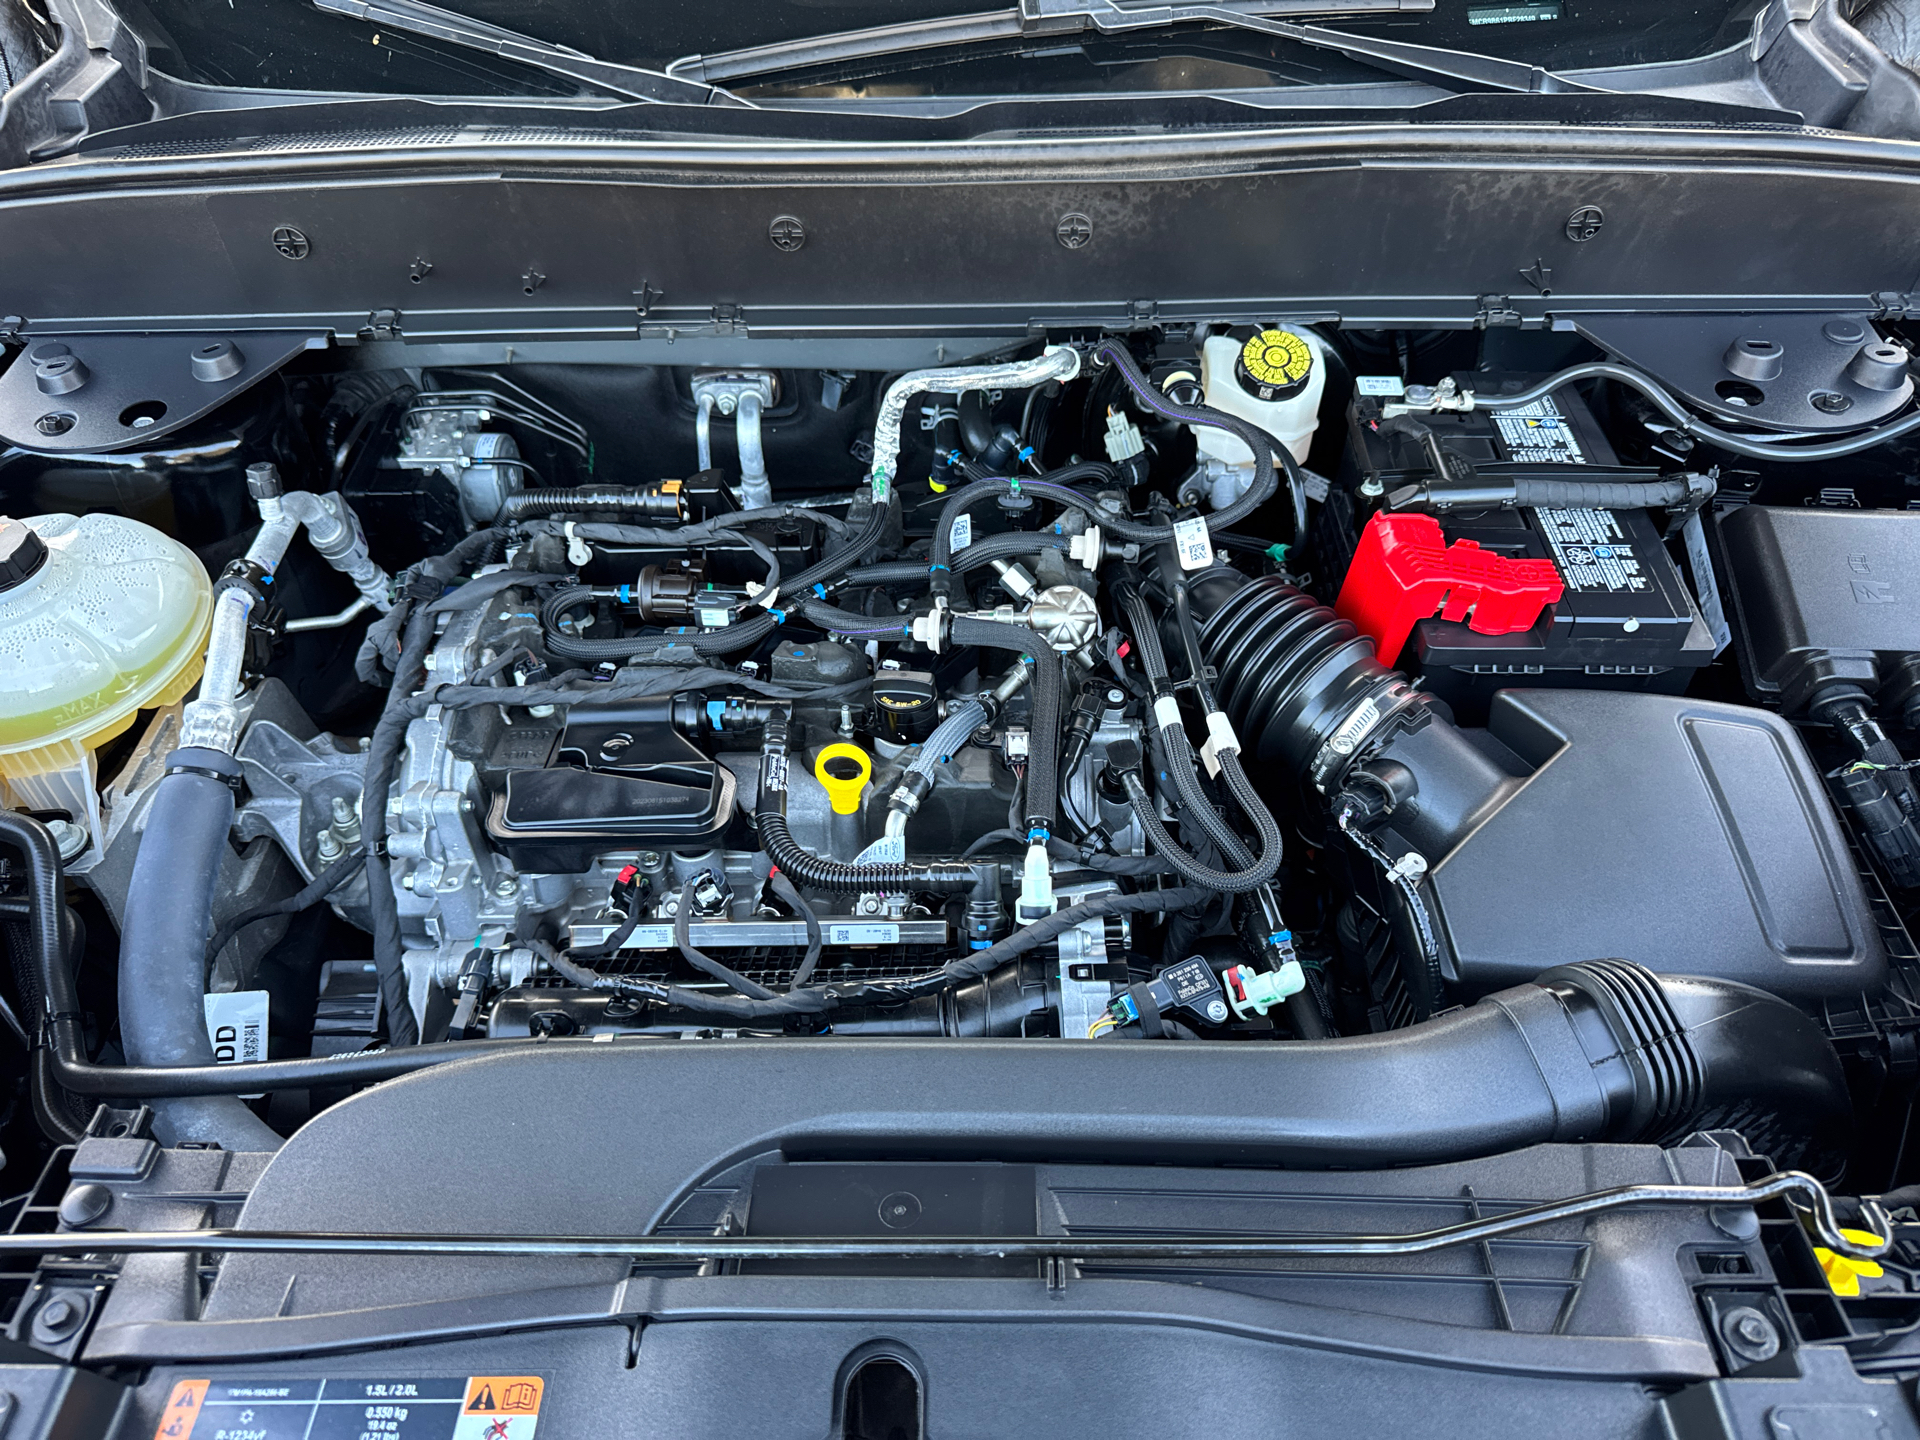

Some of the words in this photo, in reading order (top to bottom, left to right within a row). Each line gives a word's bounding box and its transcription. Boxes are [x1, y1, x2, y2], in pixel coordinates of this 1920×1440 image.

[61, 692, 110, 719] MAX
[881, 696, 894, 705] SAE
[365, 1384, 388, 1397] 1.5L
[394, 1384, 419, 1397] 2.0L
[364, 1406, 394, 1419] 0.550
[393, 1406, 409, 1422] kg
[216, 1429, 267, 1440] R-1234yf
